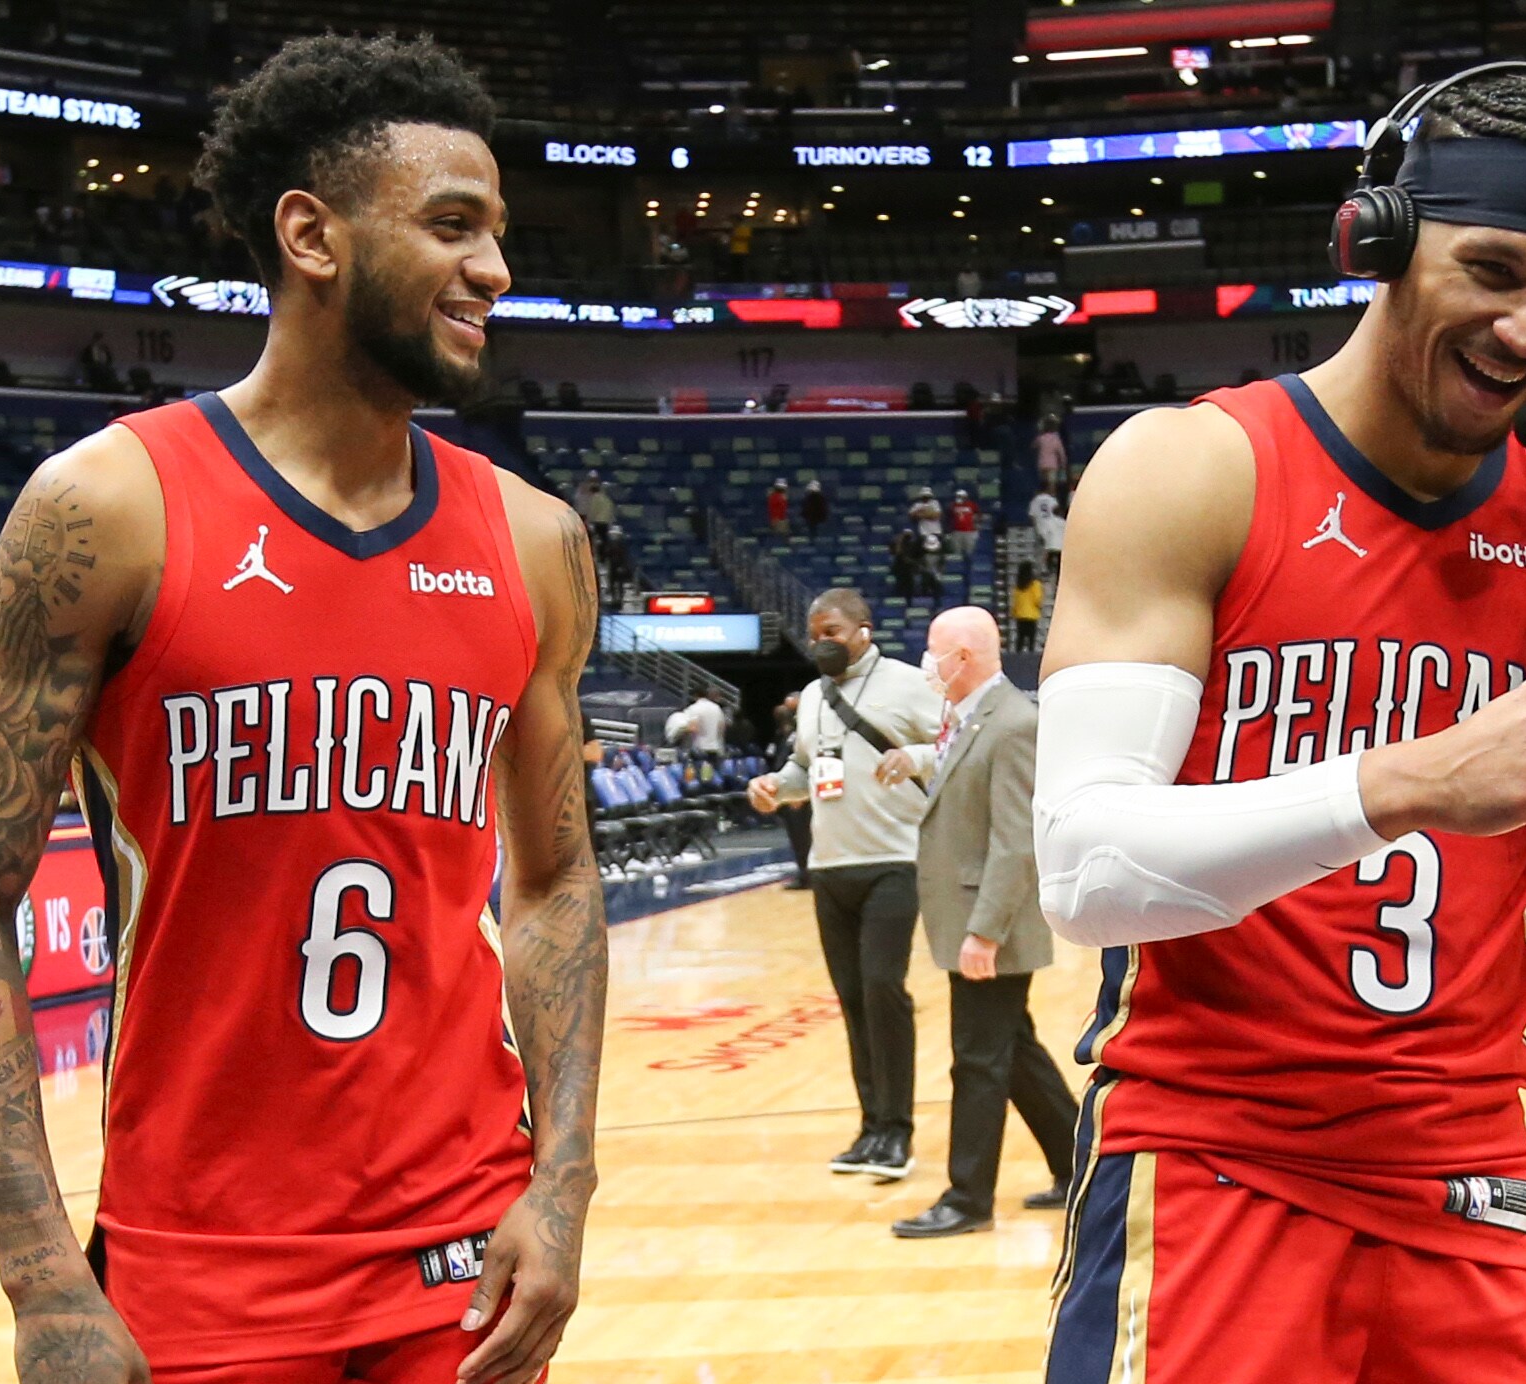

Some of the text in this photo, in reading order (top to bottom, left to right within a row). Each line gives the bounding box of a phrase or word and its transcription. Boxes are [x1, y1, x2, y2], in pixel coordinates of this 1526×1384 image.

[62, 98, 141, 130] STATS:
[545, 142, 689, 170] BLOCKS 6
[793, 145, 993, 167] TURNOVERS 12
[1109, 220, 1158, 240] HUB
[1289, 286, 1352, 308] TUNE
[408, 561, 494, 599] ibotta
[1215, 638, 1526, 785] PELICA
[45, 896, 72, 953] VS
[1348, 829, 1442, 1017] 3
[299, 857, 394, 1042] 6
